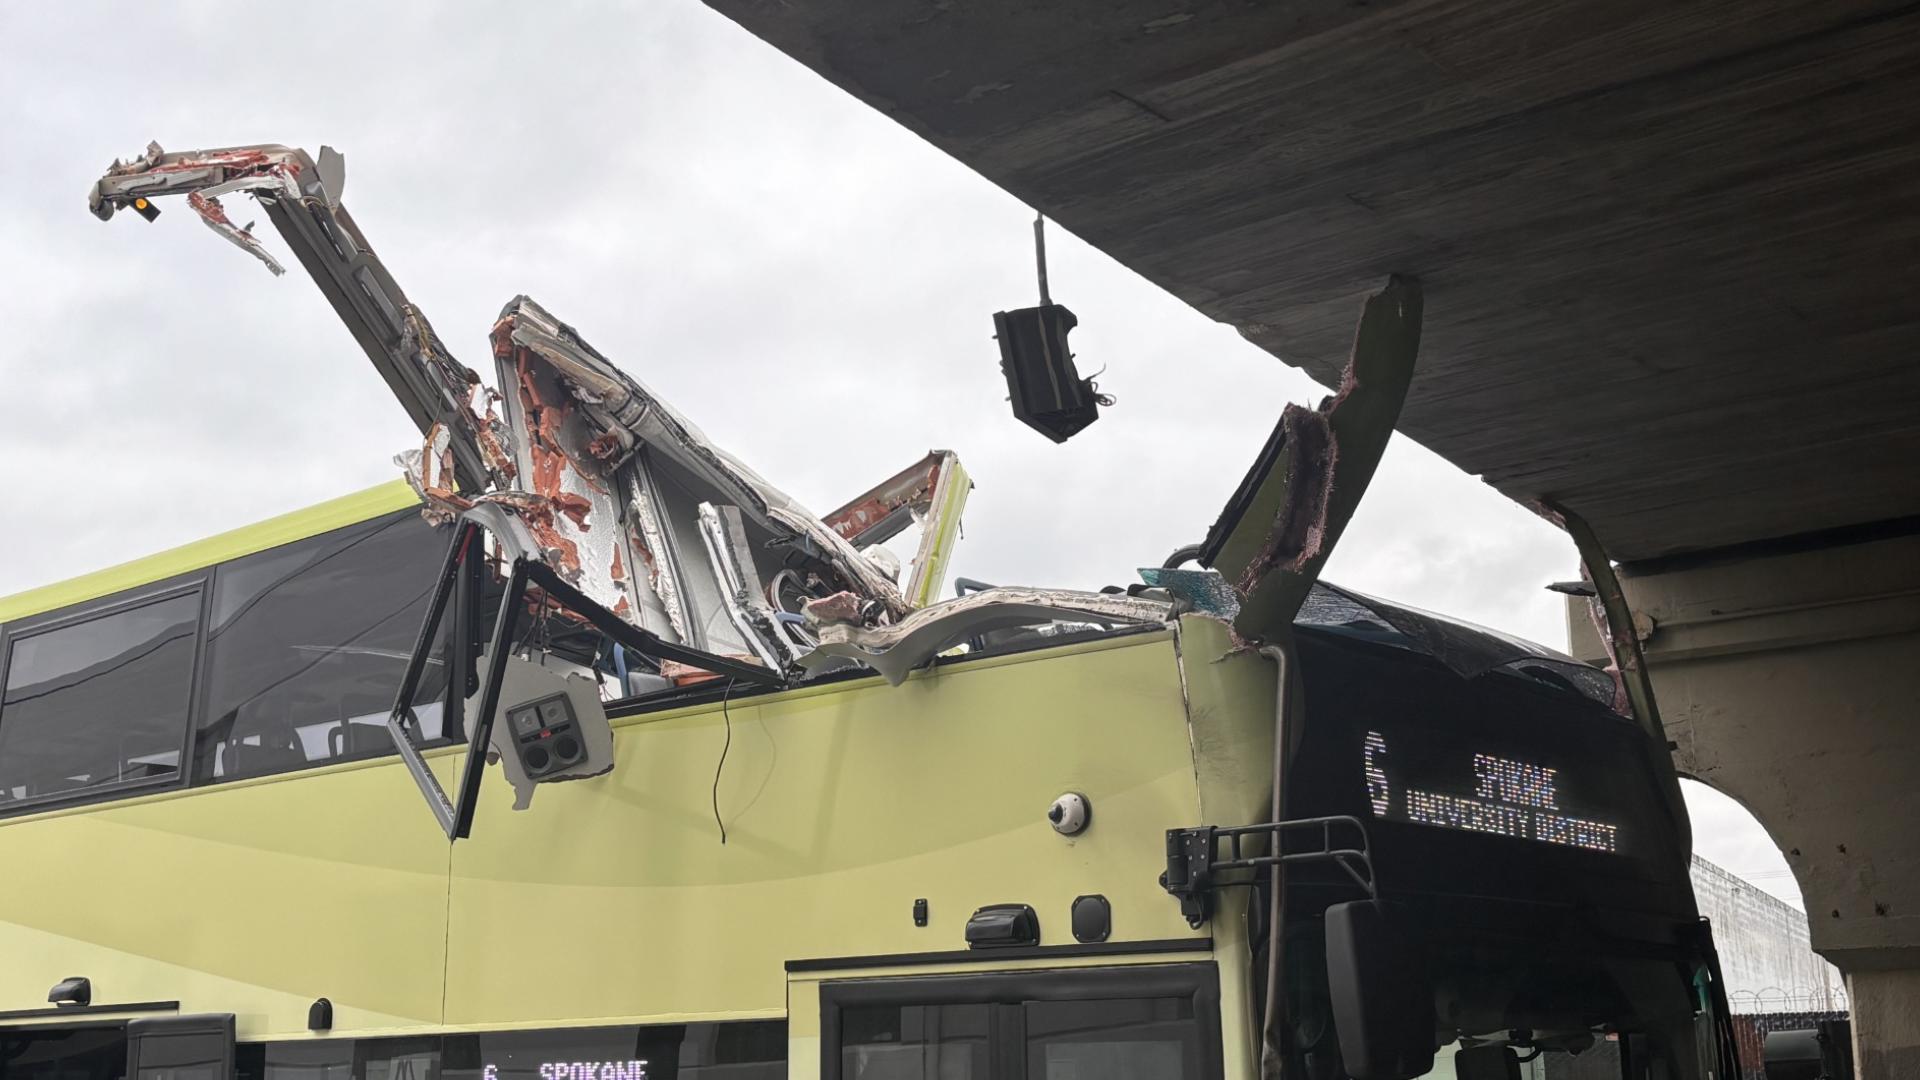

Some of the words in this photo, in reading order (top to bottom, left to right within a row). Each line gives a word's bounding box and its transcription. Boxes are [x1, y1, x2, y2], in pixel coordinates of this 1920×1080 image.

[1364, 730, 1389, 817] 6
[1474, 753, 1559, 810] SPOKANE
[1406, 789, 1529, 837] UNIVERSITY
[1535, 812, 1617, 852] DISTRICT
